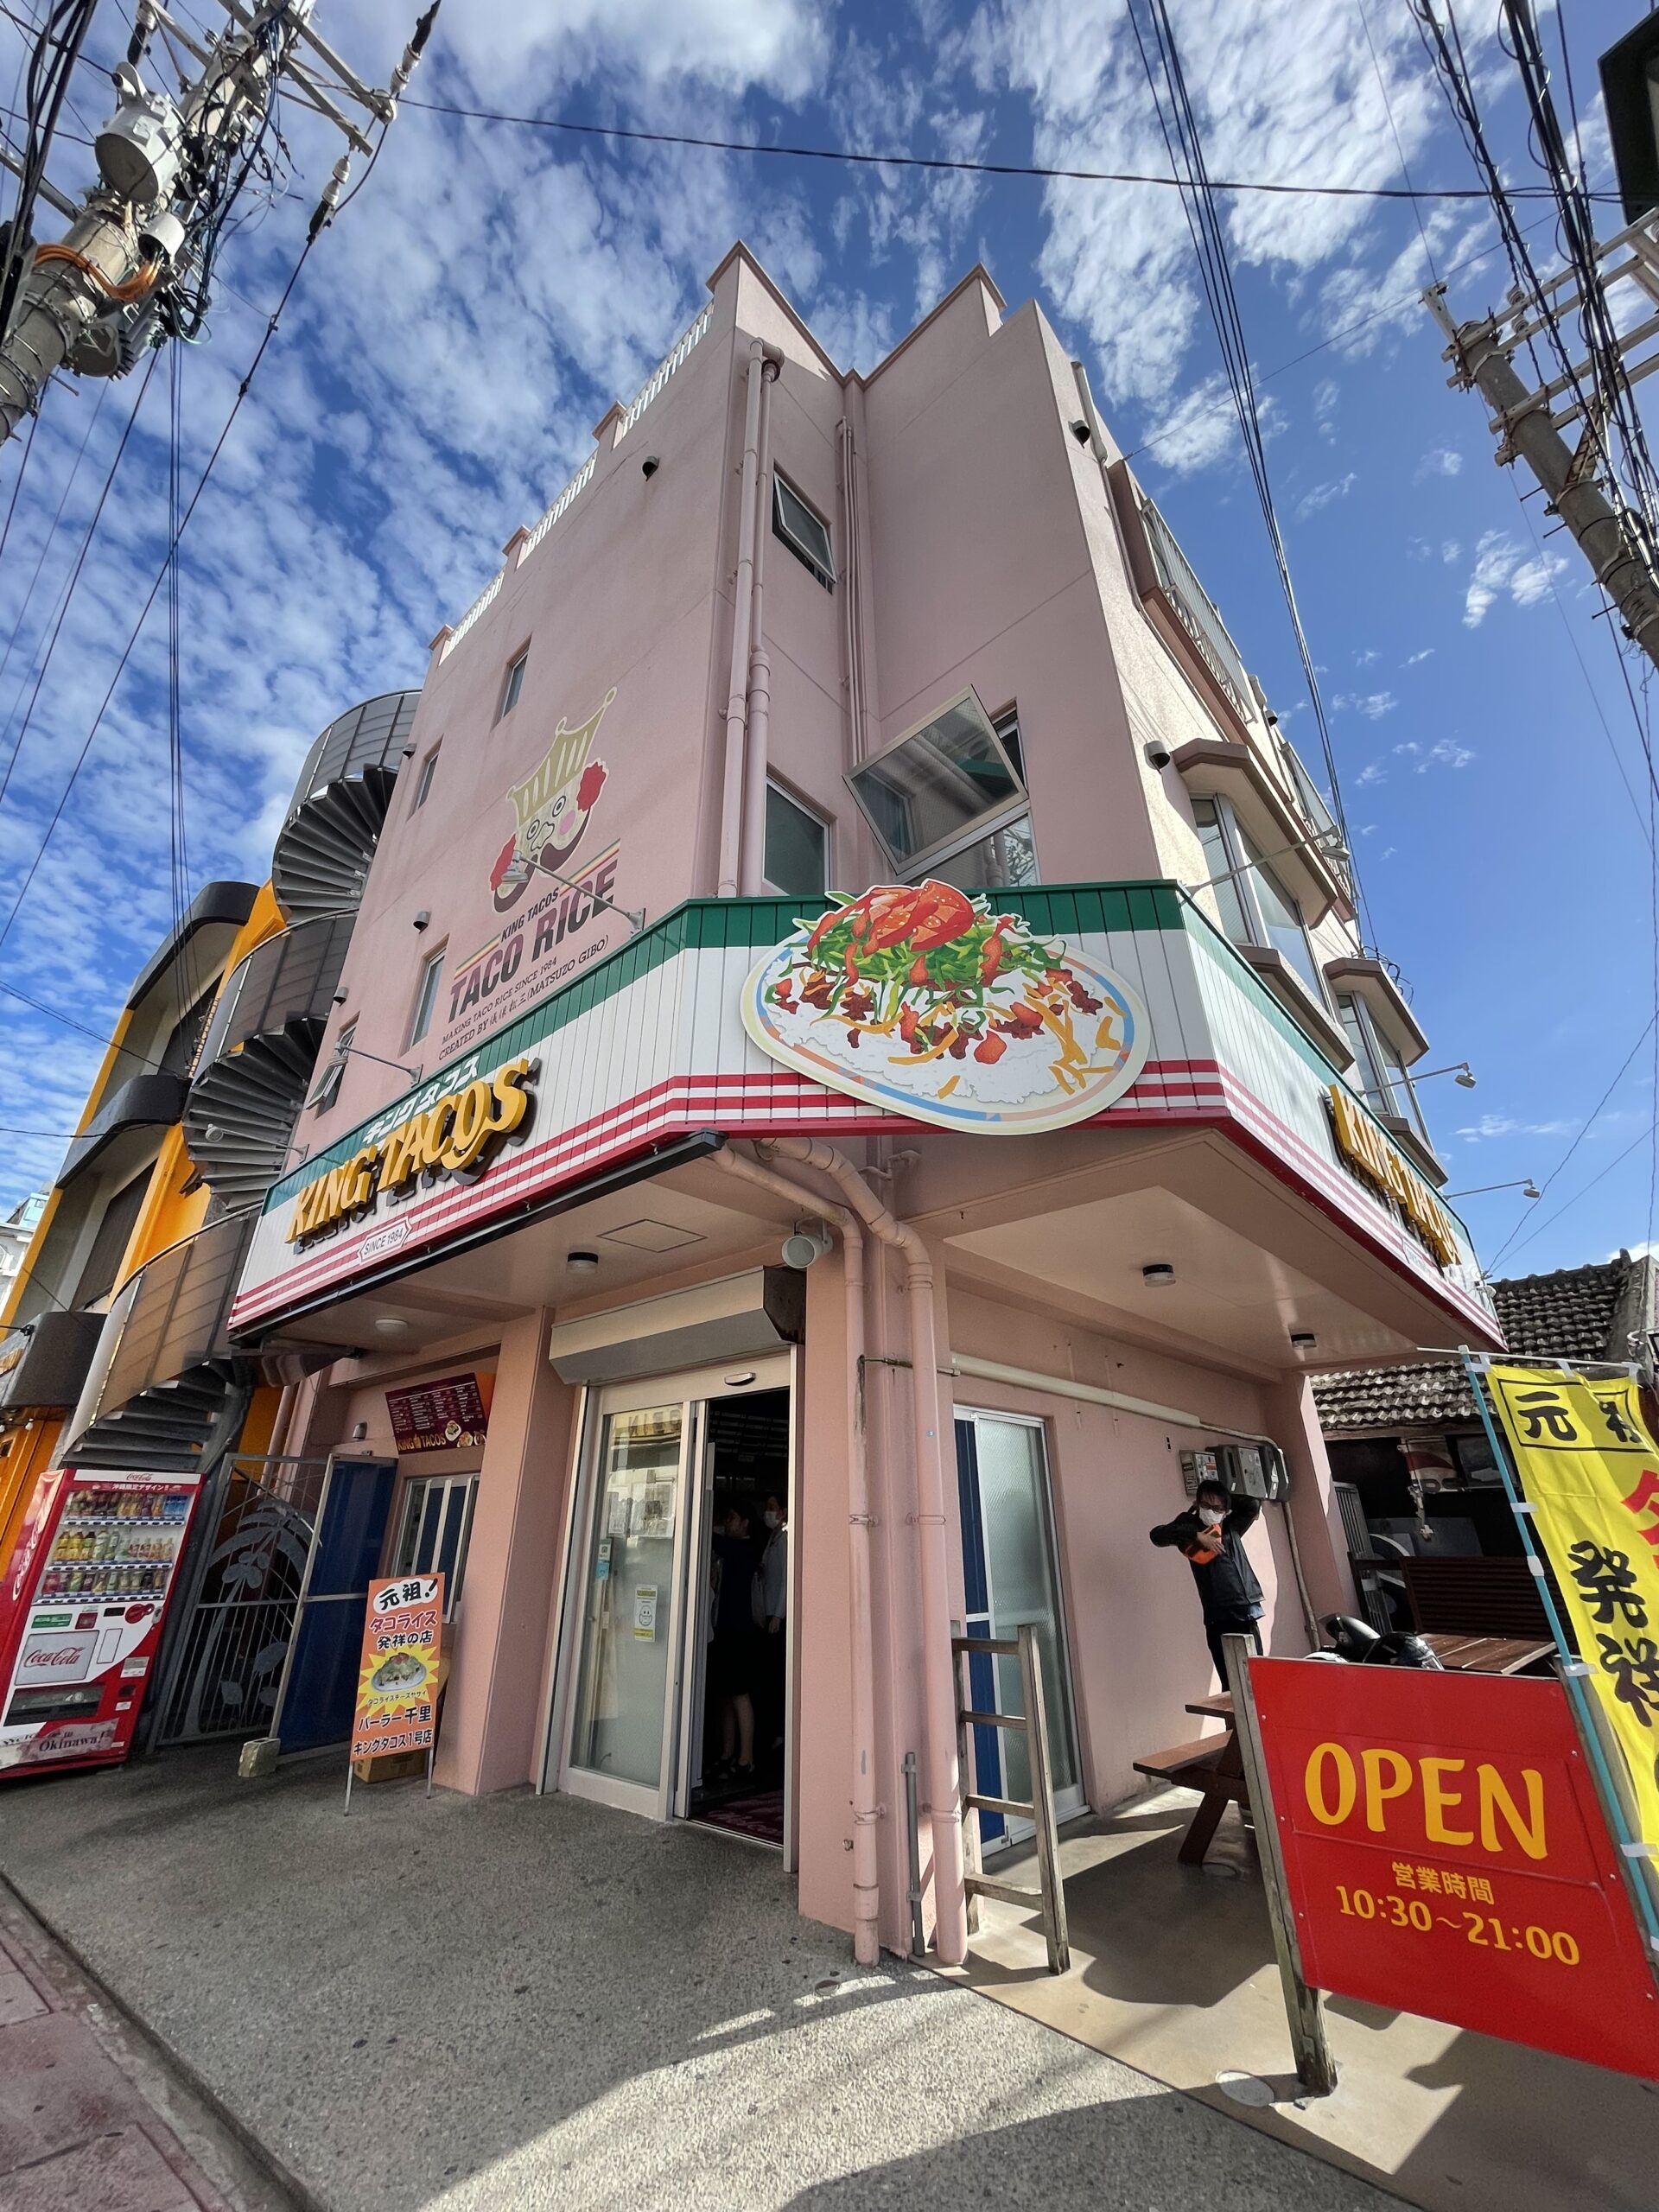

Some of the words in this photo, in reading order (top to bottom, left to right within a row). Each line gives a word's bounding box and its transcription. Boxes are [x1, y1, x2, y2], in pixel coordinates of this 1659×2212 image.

[501, 915, 524, 942] KING
[528, 887, 560, 922] TACOS
[448, 934, 524, 1023] TACO
[531, 858, 618, 963] RICE
[438, 1028, 475, 1061] CREATED
[477, 1019, 489, 1035] BY
[527, 959, 575, 1001] (MATSUZO
[578, 934, 609, 964] GIBO)
[442, 1018, 471, 1044] MAKING
[474, 1002, 493, 1023] TACO
[495, 988, 513, 1007] RICE
[514, 970, 538, 995] SINCE
[540, 957, 557, 976] 1984
[284, 1145, 378, 1244] KING
[377, 1058, 530, 1192] TACOS
[364, 1235, 387, 1255] SINCE
[387, 1227, 404, 1245] 1984
[421, 1434, 447, 1448] TACOS
[370, 1611, 437, 1633] タコライス
[378, 1630, 433, 1649] 発祥の店
[39, 1731, 105, 1752] Okinawa!
[353, 1729, 433, 1756] キングタコス1号店
[1305, 1742, 1548, 1859] OPEN
[1392, 1860, 1496, 1905] 営業時間
